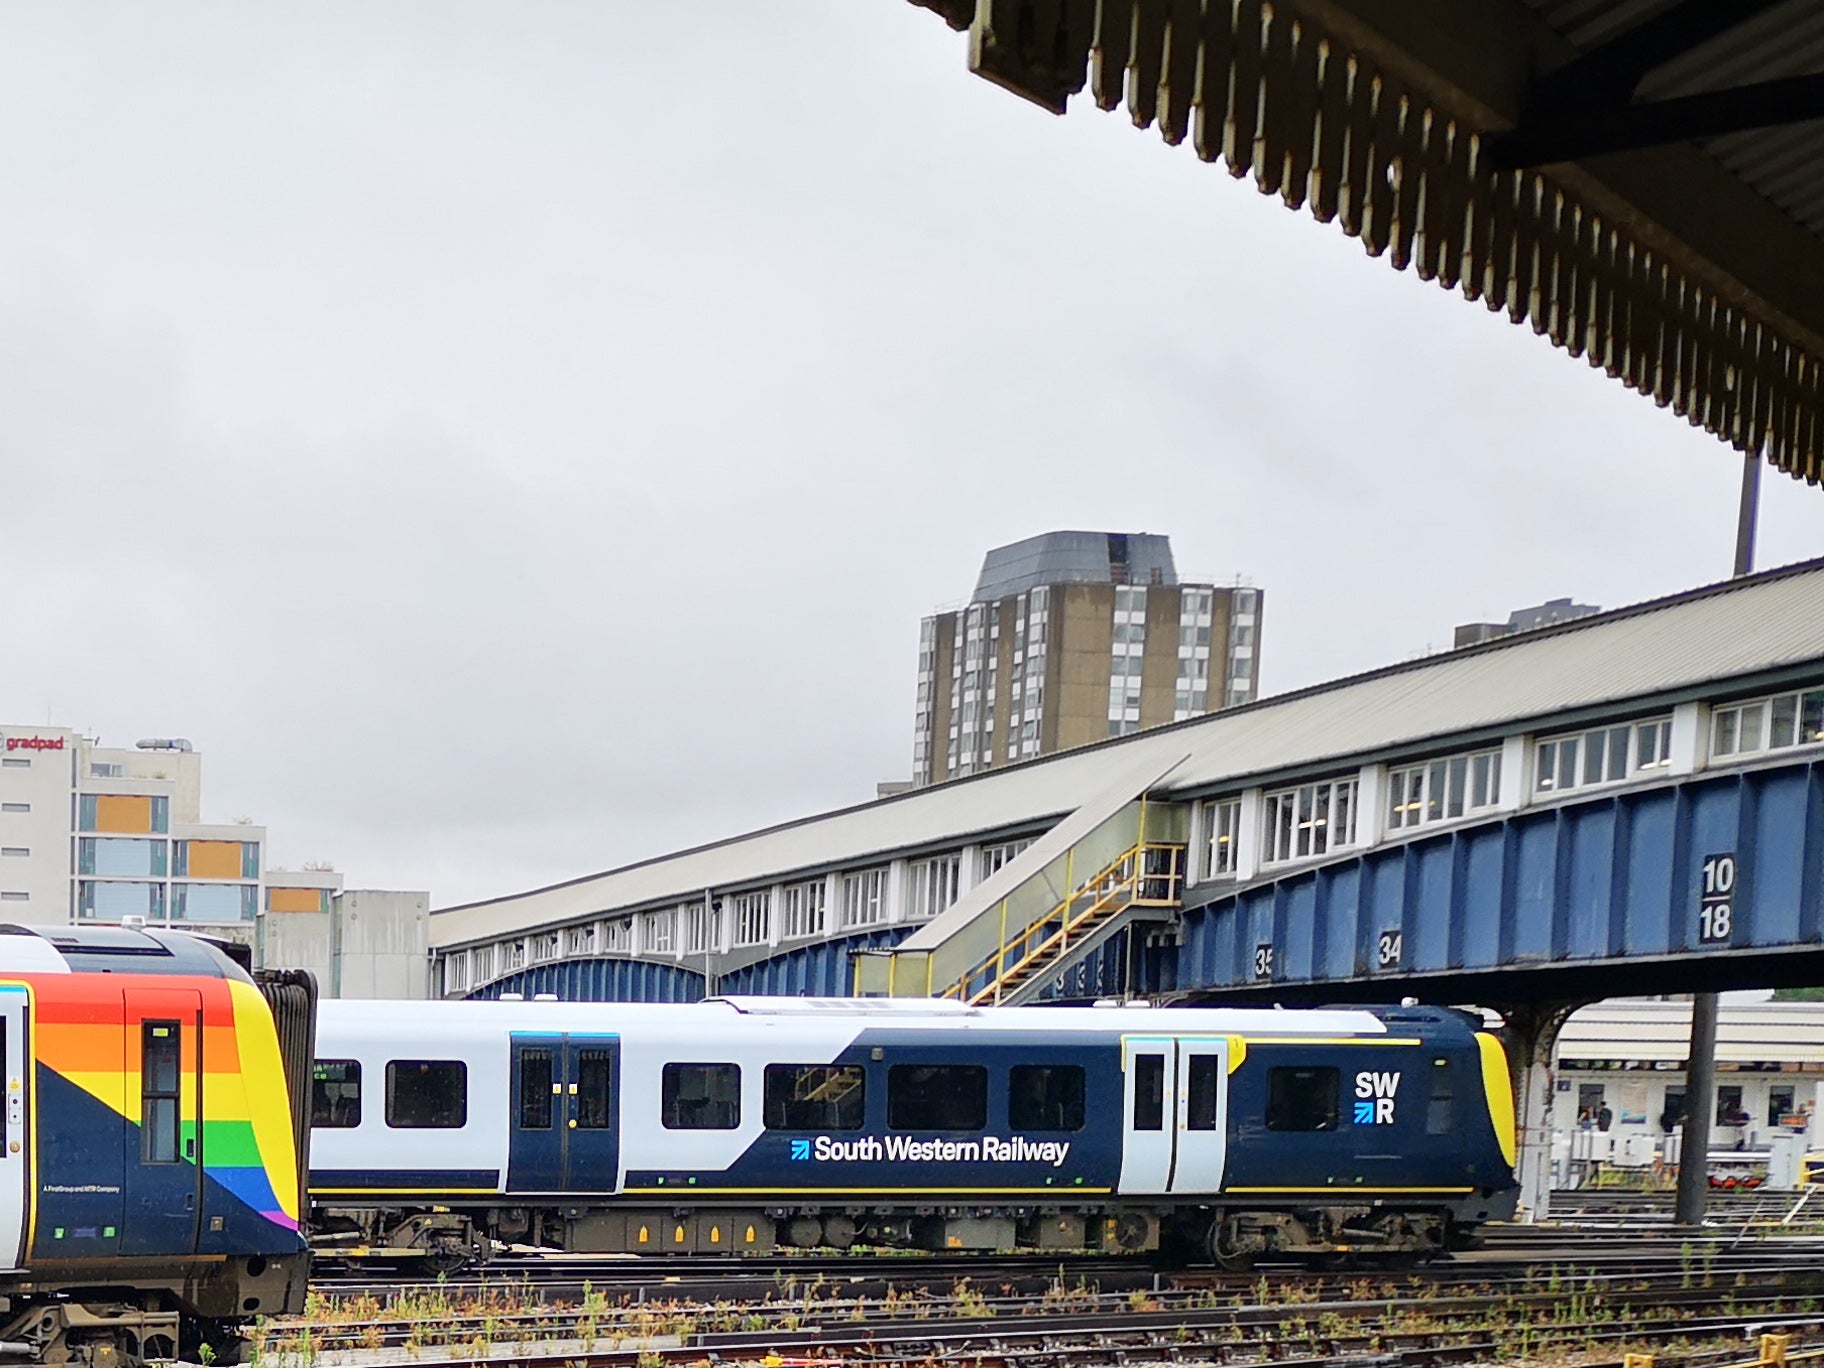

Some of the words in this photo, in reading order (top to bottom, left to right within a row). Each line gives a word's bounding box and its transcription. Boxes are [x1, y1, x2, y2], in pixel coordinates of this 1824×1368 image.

[6, 735, 64, 751] gradpad
[1703, 857, 1734, 893] 10
[1700, 904, 1731, 938] 18
[1379, 934, 1402, 964] 34
[1355, 1071, 1401, 1098] SW
[1376, 1098, 1395, 1124] R
[814, 1135, 883, 1161] South
[884, 1135, 980, 1161] Western
[982, 1136, 1071, 1167] Railway
